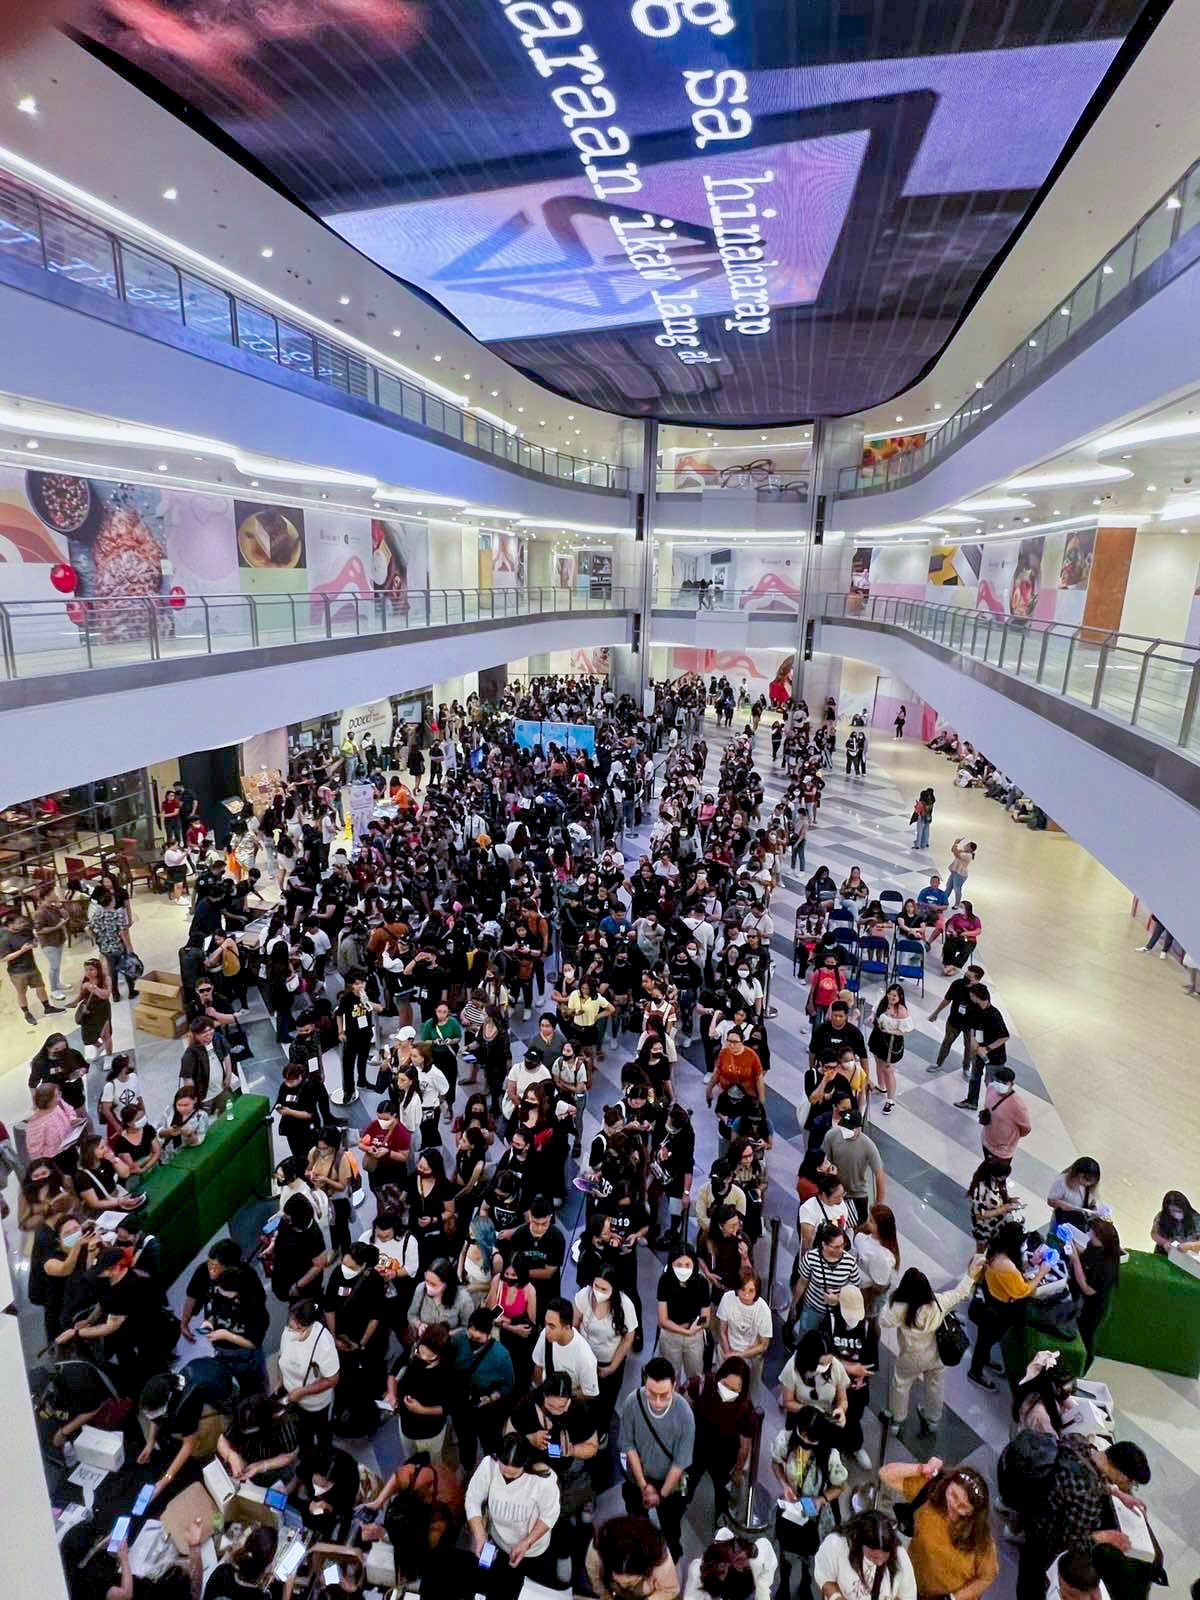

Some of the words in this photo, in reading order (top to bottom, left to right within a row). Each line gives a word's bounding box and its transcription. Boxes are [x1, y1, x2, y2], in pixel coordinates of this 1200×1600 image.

[503, 0, 643, 200] araan
[609, 214, 682, 281] ikaw
[650, 289, 700, 348] lang
[682, 69, 752, 149] sa
[702, 170, 779, 336] hinaharap
